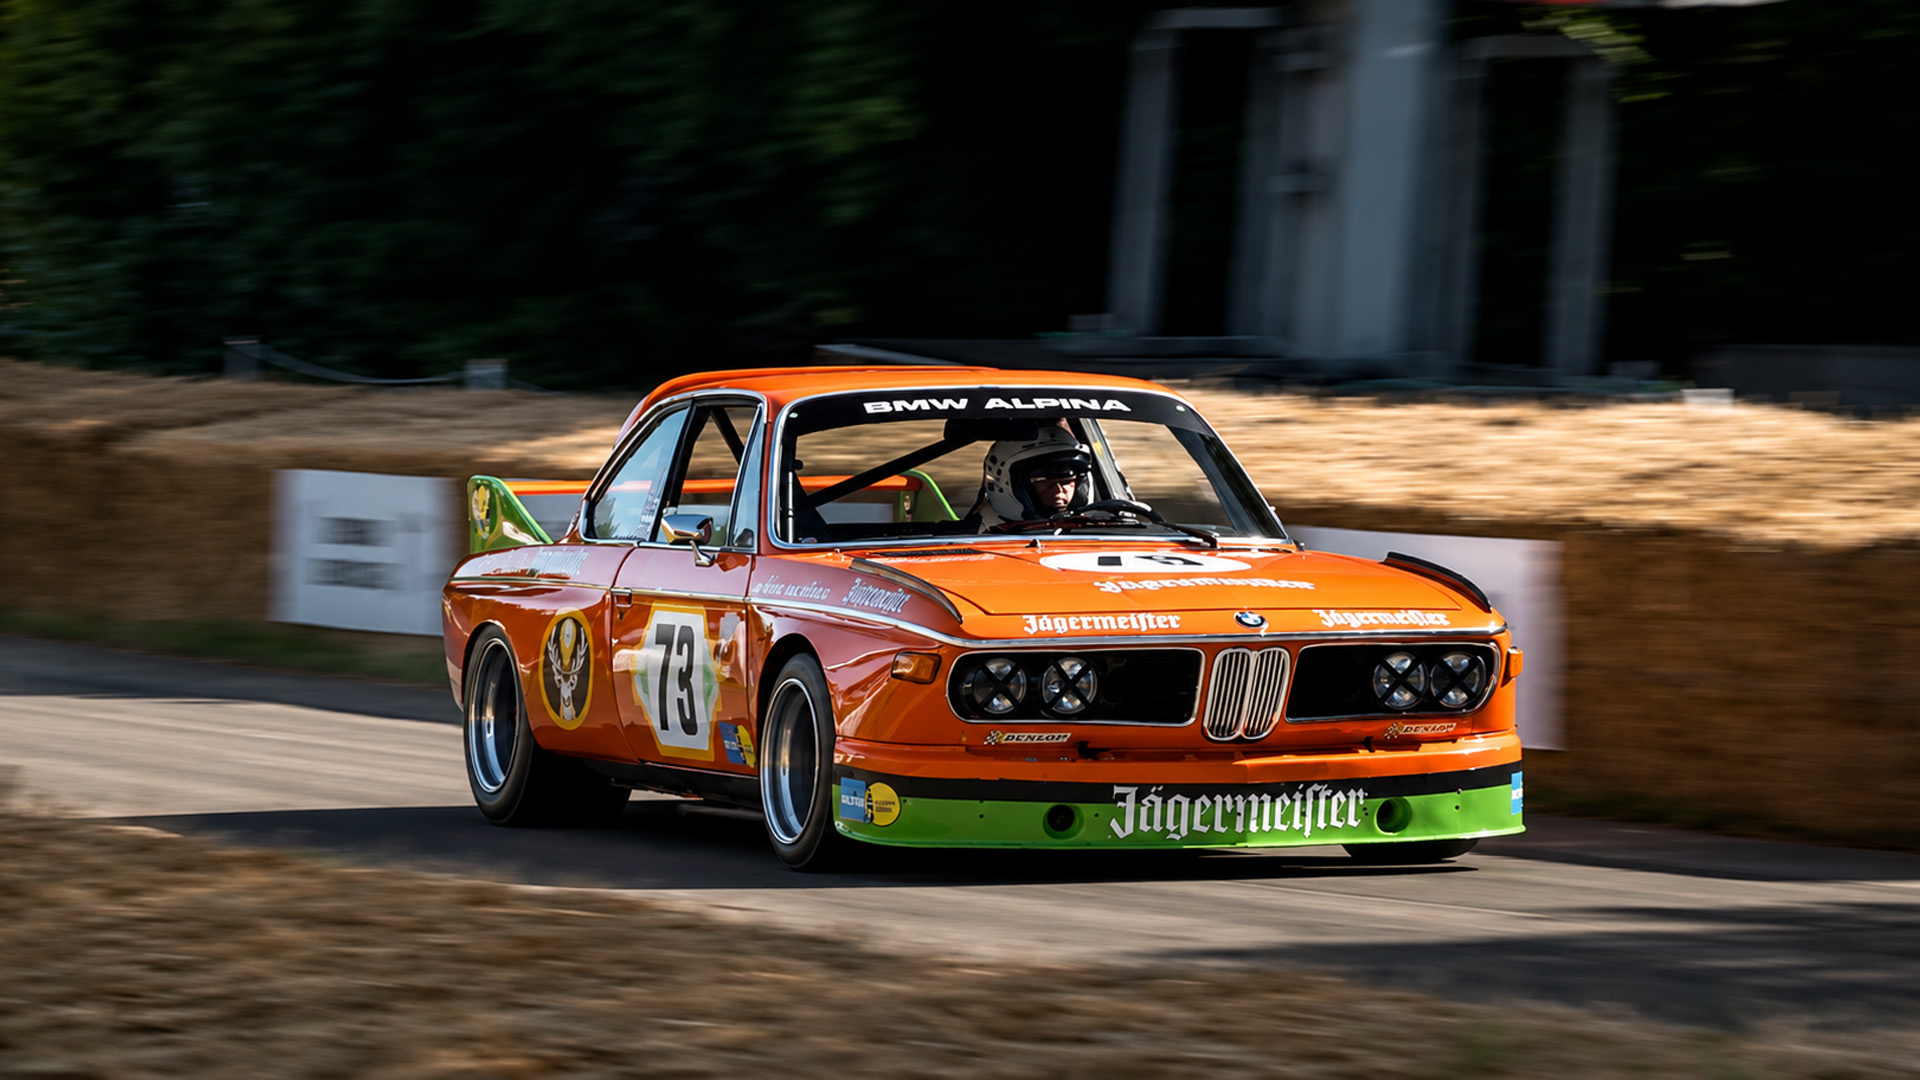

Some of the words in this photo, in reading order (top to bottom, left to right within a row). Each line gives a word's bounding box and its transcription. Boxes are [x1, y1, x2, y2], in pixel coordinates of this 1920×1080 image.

[863, 398, 968, 414] BMW
[984, 398, 1132, 412] ALPINA
[655, 623, 699, 736] 73
